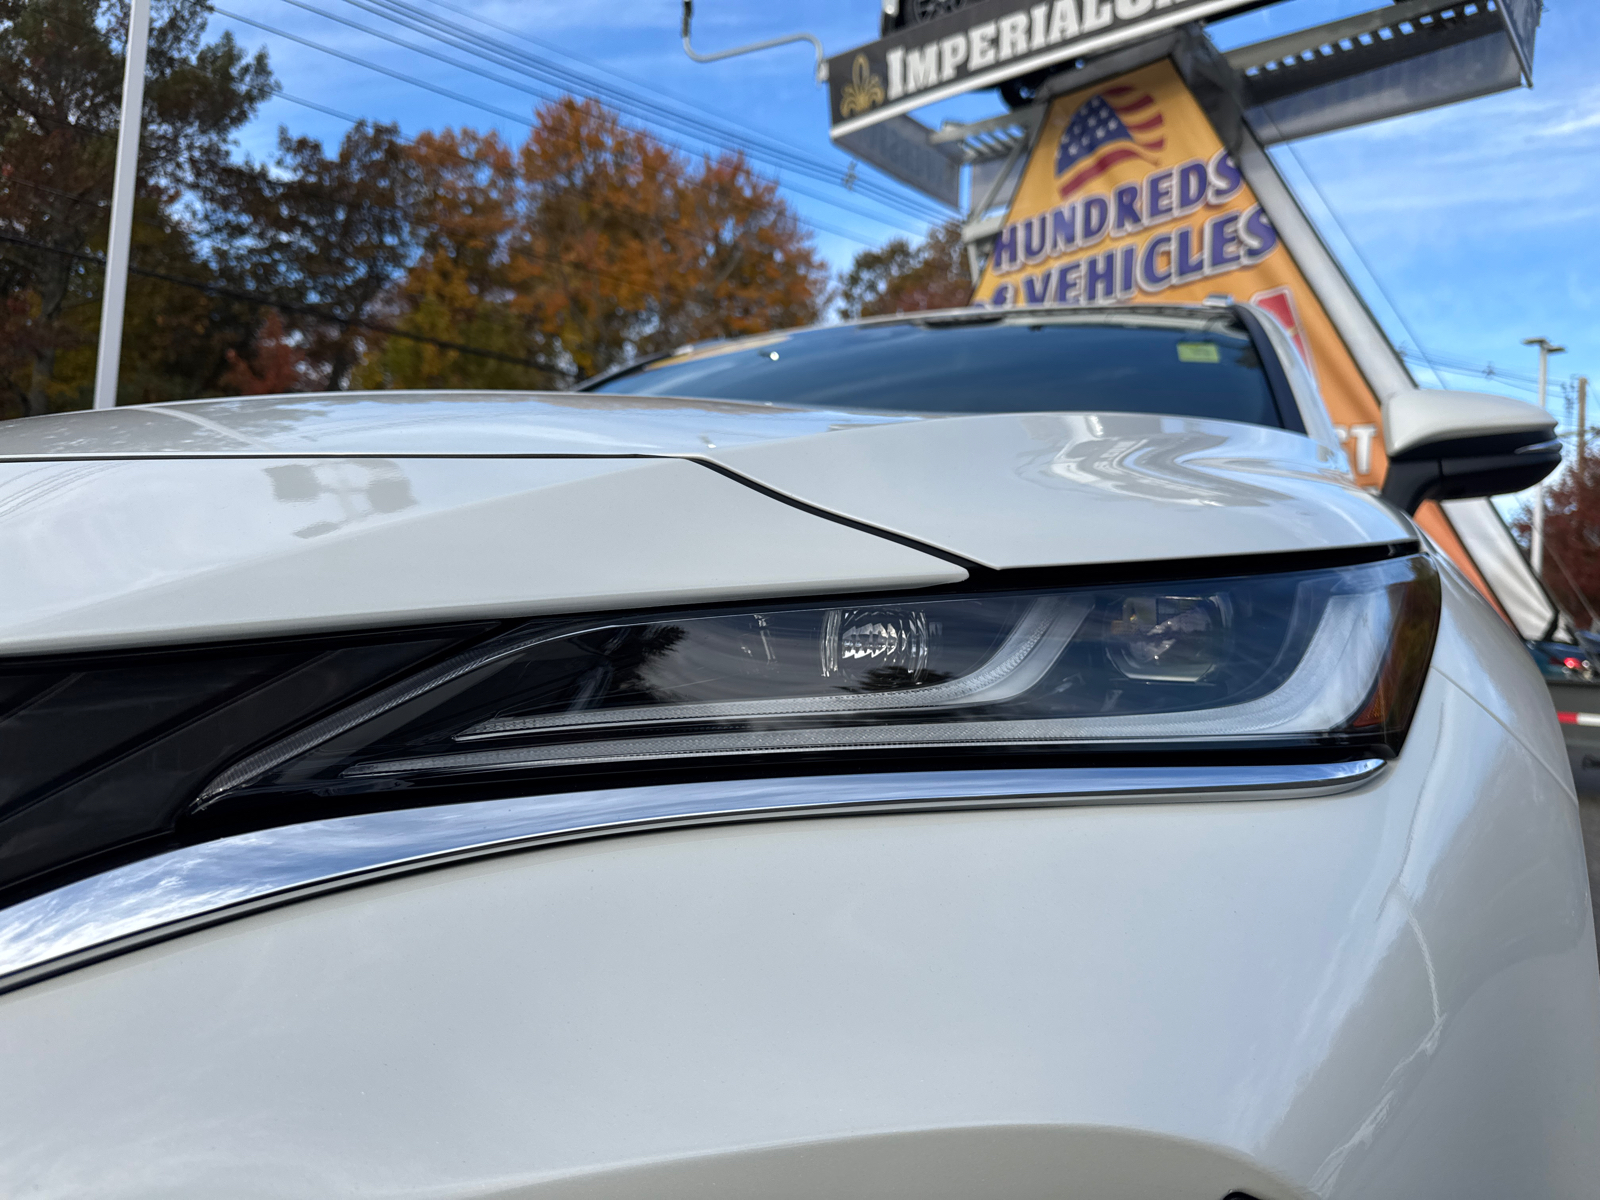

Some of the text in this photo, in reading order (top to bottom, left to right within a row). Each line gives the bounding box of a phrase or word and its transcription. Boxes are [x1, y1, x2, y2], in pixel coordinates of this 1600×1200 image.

[886, 0, 1188, 100] IMPERIAL
[991, 150, 1245, 275] HUNDREDS
[1020, 203, 1279, 307] VEHICLES
